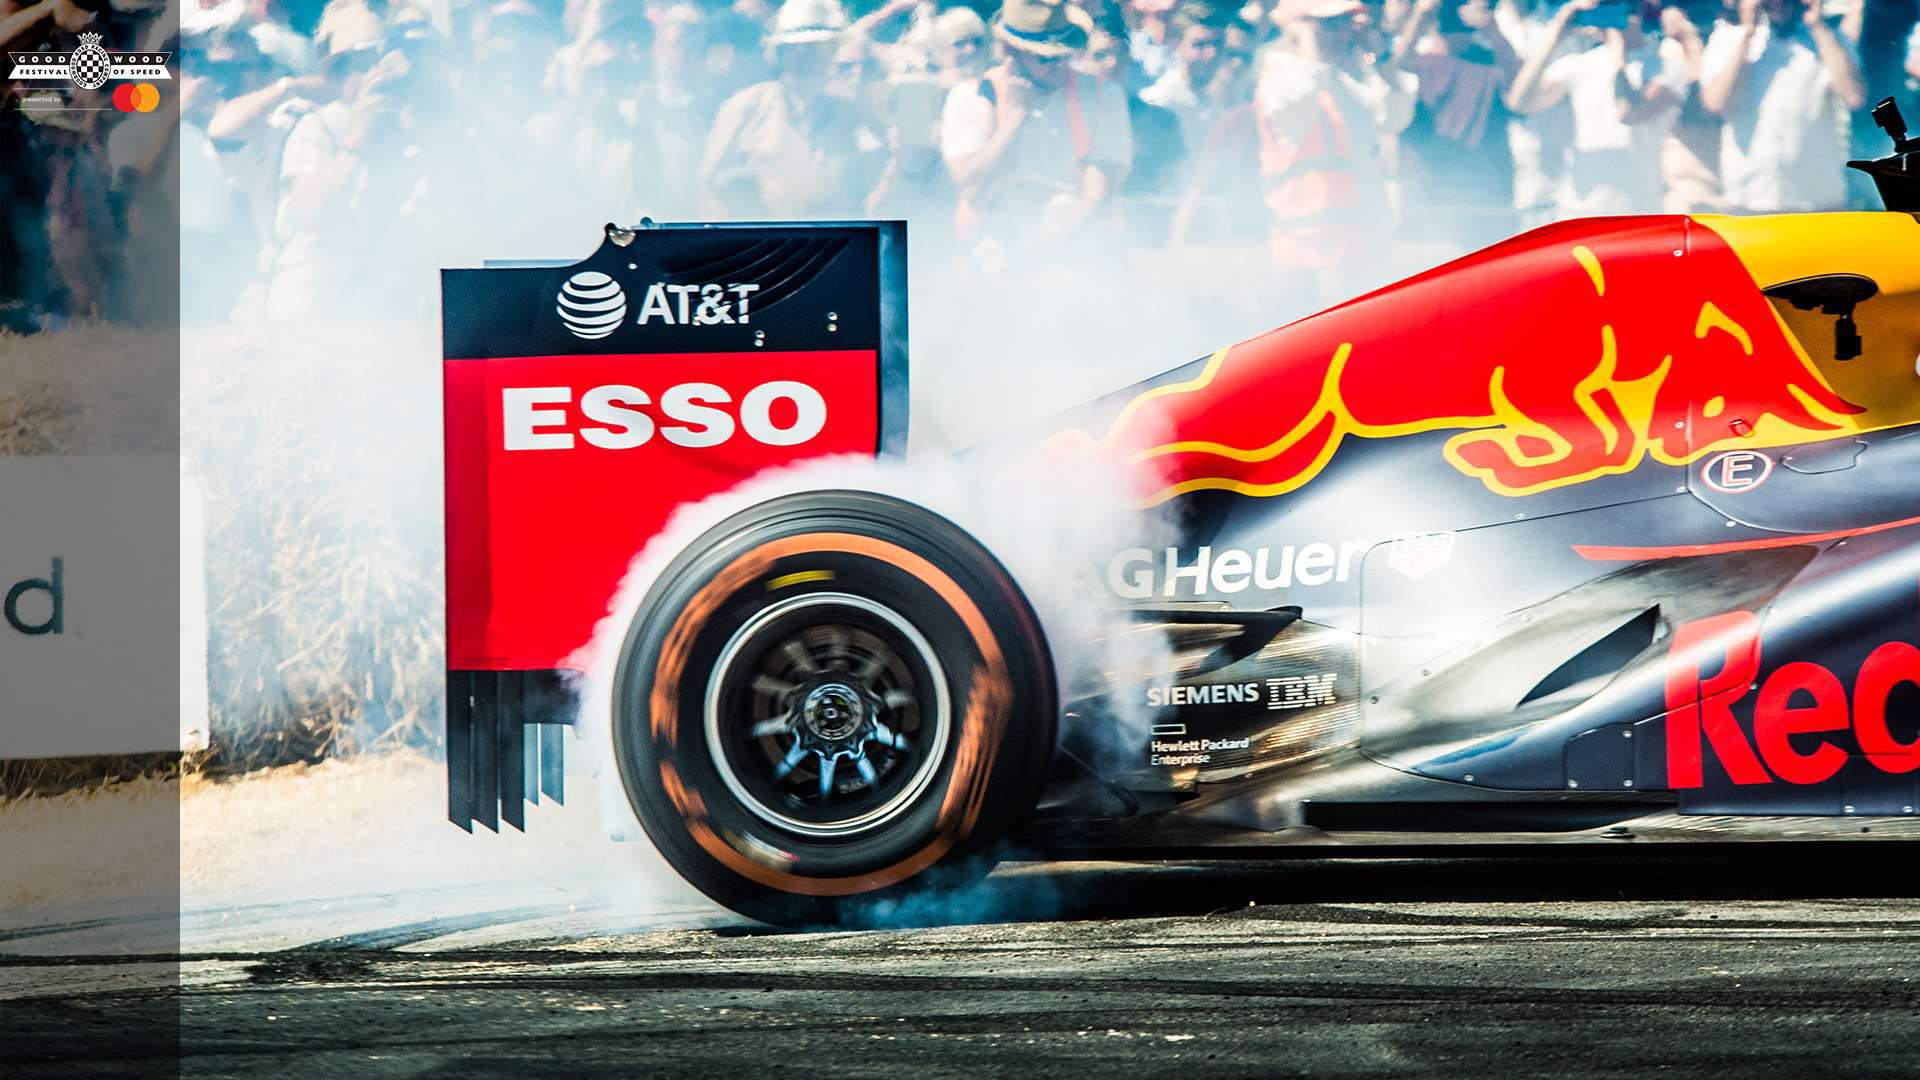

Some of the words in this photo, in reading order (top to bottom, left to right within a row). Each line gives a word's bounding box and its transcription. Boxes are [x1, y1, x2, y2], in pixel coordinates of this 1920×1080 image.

[636, 282, 760, 325] AT&T
[502, 380, 827, 451] ESSO
[1721, 454, 1755, 487] E
[1163, 539, 1373, 597] Heuer
[1146, 682, 1260, 706] SIEMENS
[1265, 673, 1338, 710] IBM
[1151, 739, 1200, 753] Hewlett
[1201, 737, 1250, 751] Packard
[1151, 753, 1211, 766] Enterprise
